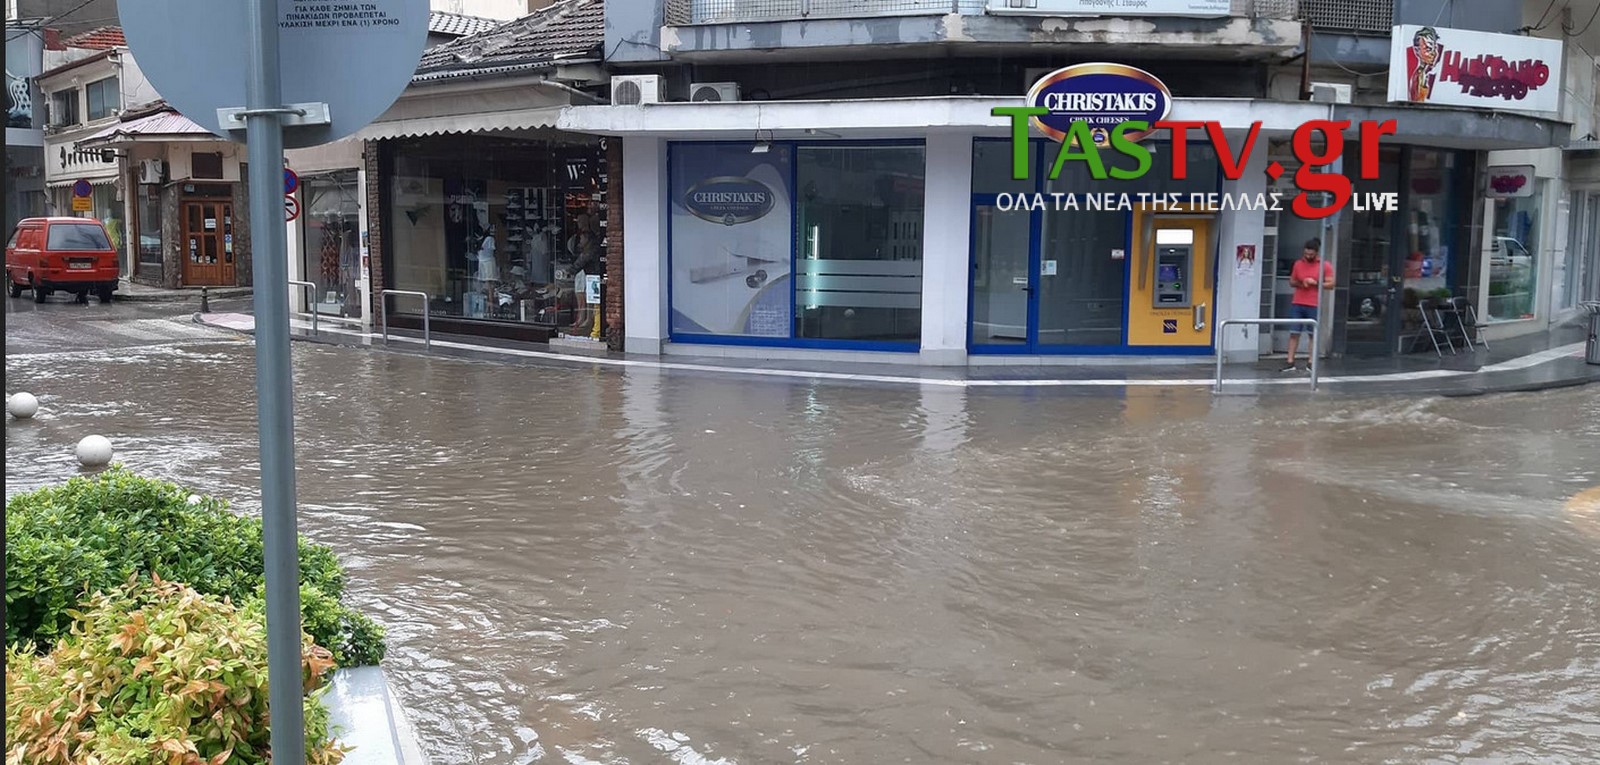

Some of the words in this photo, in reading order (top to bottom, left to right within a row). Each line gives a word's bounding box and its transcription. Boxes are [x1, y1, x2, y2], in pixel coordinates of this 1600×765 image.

[286, 12, 330, 20] ΠΙΝΑΚΙΔΩΝ
[332, 11, 387, 19] ΠΡΟΒΛΕΠΕΤΑΙ
[342, 19, 358, 27] ΕΝΑ
[360, 19, 371, 27] (1)
[372, 18, 400, 26] ΧΡΟΝΟ
[1044, 92, 1157, 112] CHRISTAKIS
[693, 192, 766, 203] CHRISTAKIS
